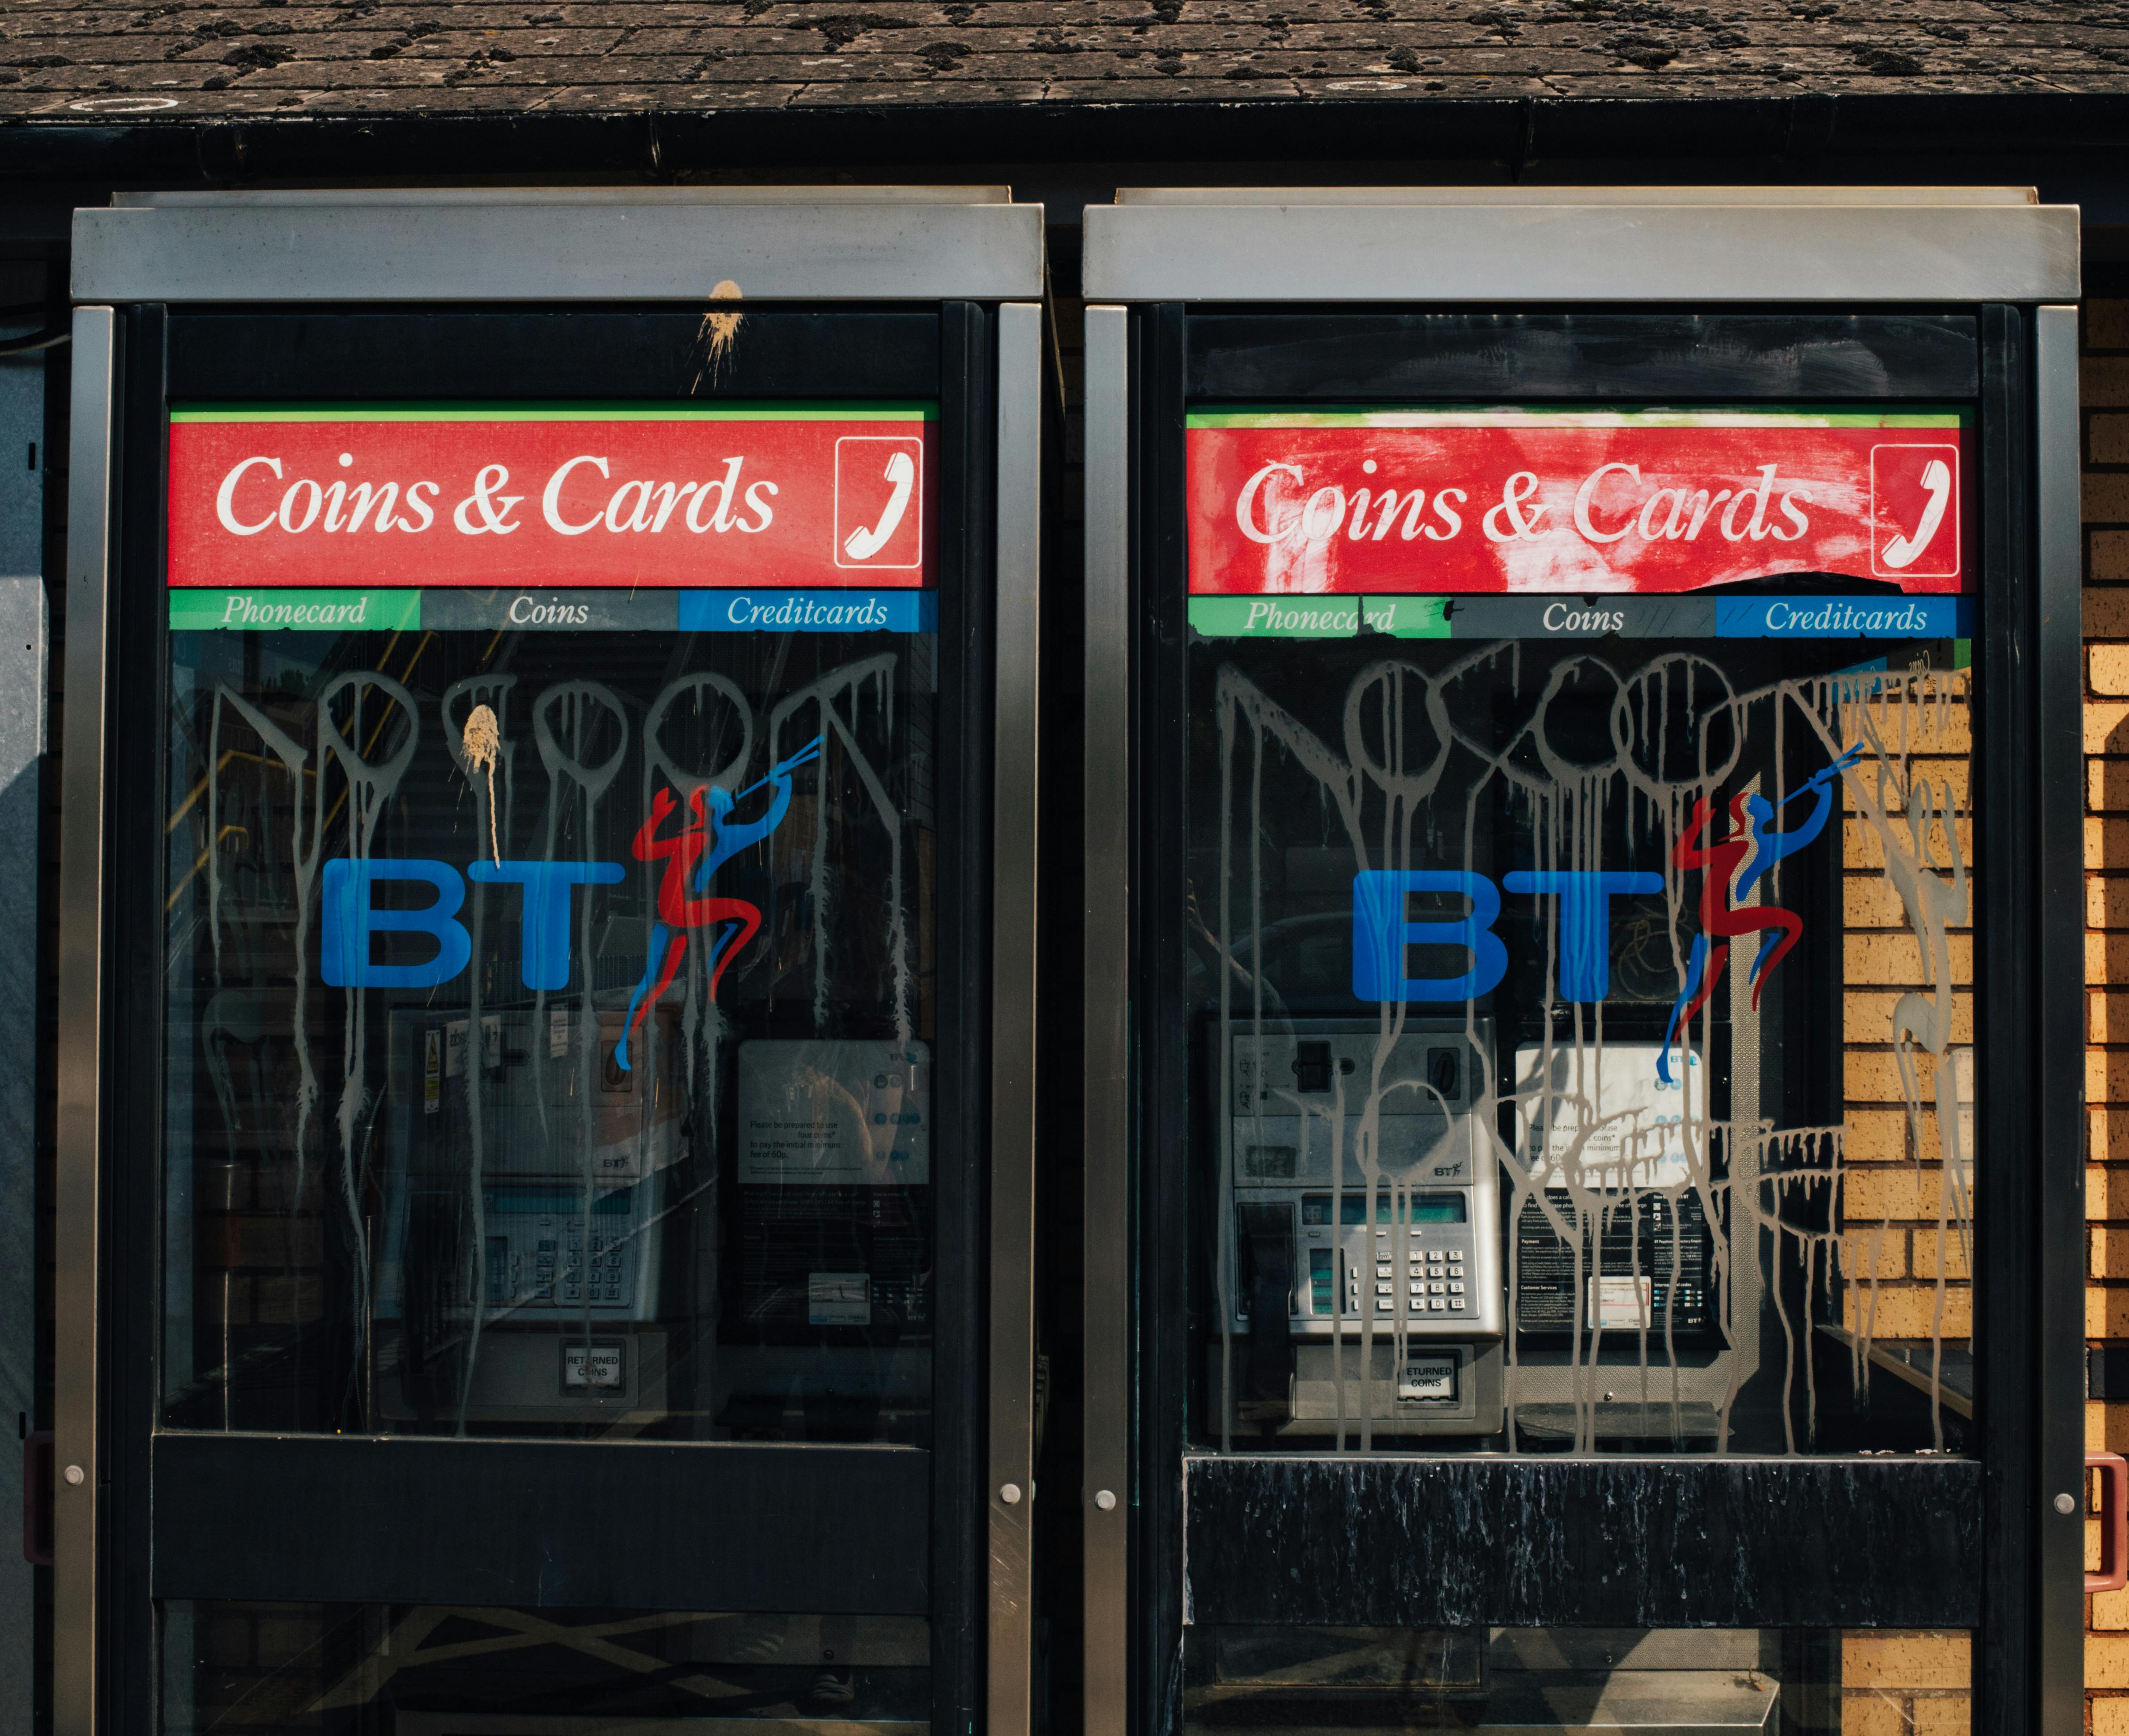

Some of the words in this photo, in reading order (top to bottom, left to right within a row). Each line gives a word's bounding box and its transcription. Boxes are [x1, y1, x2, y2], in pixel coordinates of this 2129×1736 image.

[217, 453, 439, 536] Coins
[454, 464, 525, 535] &
[542, 456, 779, 536] Cards
[1236, 459, 1467, 542] Coins
[1483, 471, 1554, 542] &
[1574, 463, 1810, 542] Cards
[221, 596, 367, 624] Phonecard
[509, 596, 589, 624] Coins
[727, 596, 887, 626] Creditcards
[1244, 602, 1396, 631] Phonecard
[1543, 602, 1624, 631] Coins
[1766, 602, 1927, 631] Creditcards
[320, 857, 625, 990] BT
[1352, 870, 1664, 1003] BT
[784, 1121, 815, 1131] prepared
[603, 1159, 621, 1167] BT
[1434, 1168, 1453, 1176] BT
[578, 1368, 607, 1376] CINS
[1407, 1367, 1451, 1375] ETURNED
[1411, 1379, 1441, 1387] COINS
